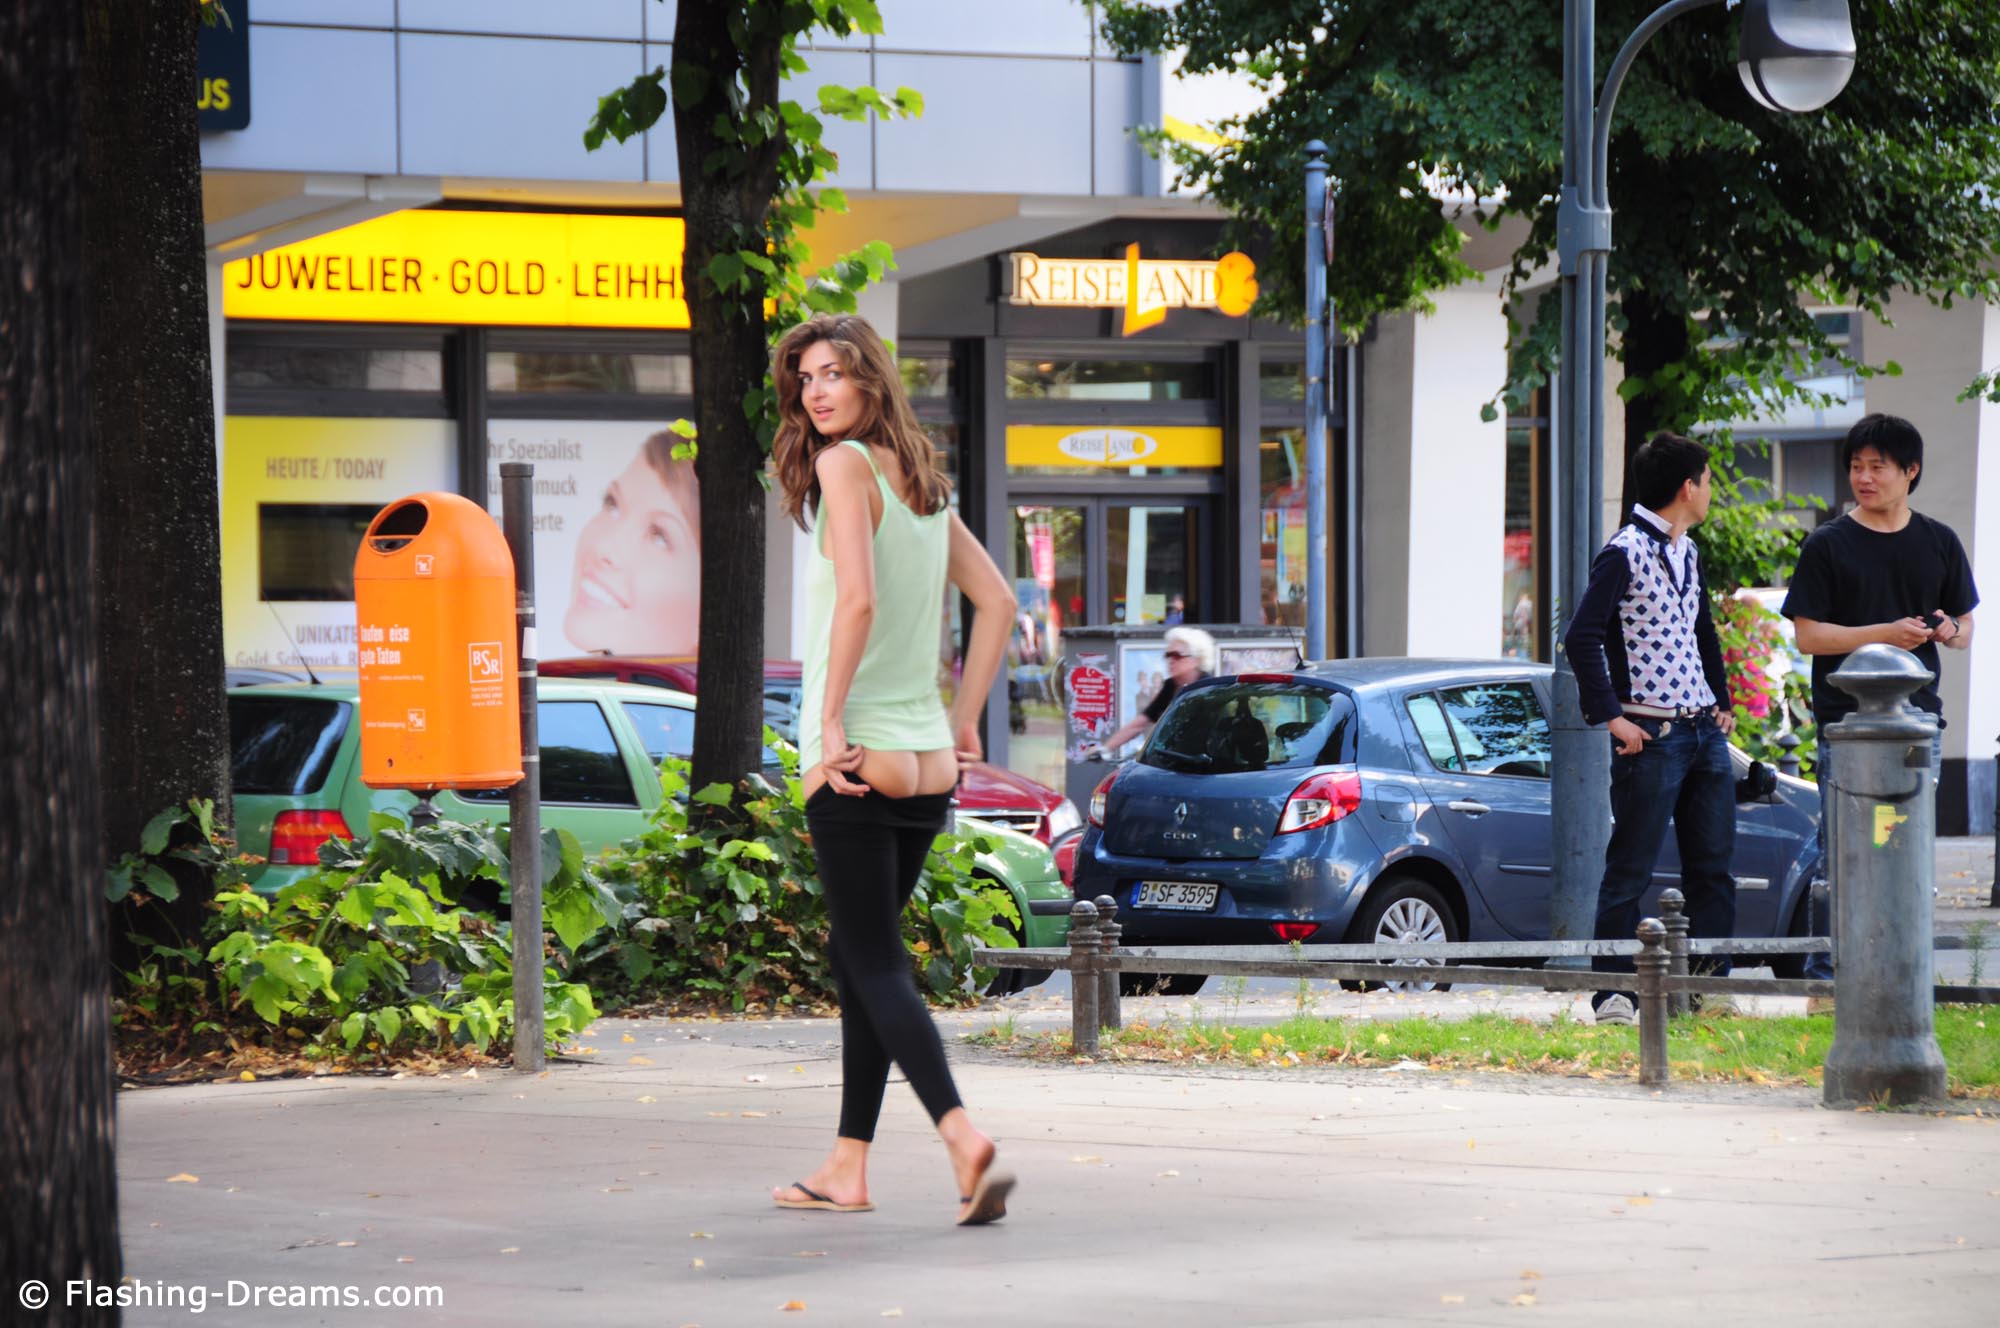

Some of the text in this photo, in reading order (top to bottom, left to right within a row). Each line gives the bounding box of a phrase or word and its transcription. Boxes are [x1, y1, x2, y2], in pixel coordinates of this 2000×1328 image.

[237, 253, 676, 299] JUWELIER GOLD LEIHH
[508, 437, 583, 462] Spezialist
[265, 456, 320, 479] HEUTE
[334, 456, 385, 480] TODAY
[473, 650, 500, 676] BSR
[1162, 831, 1198, 841] CLIO
[1138, 883, 1217, 905] B SF 3595
